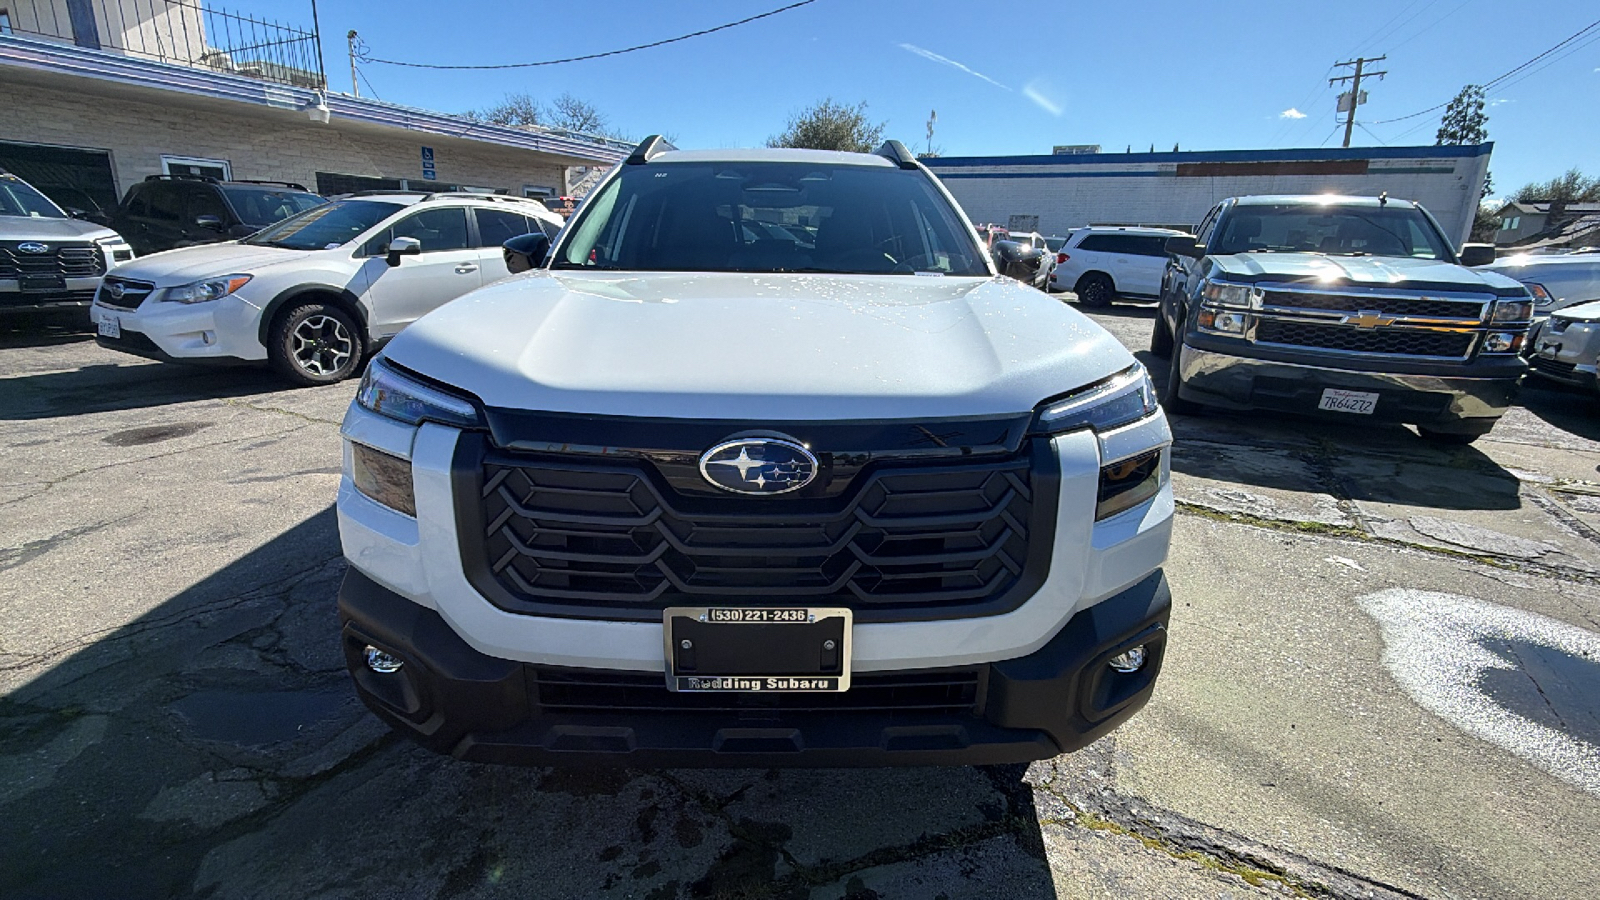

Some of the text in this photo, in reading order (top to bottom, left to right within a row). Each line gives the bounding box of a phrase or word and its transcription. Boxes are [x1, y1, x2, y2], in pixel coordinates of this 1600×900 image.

[711, 609, 806, 621] (530) 221-2436
[688, 678, 829, 690] Redding Subaru
